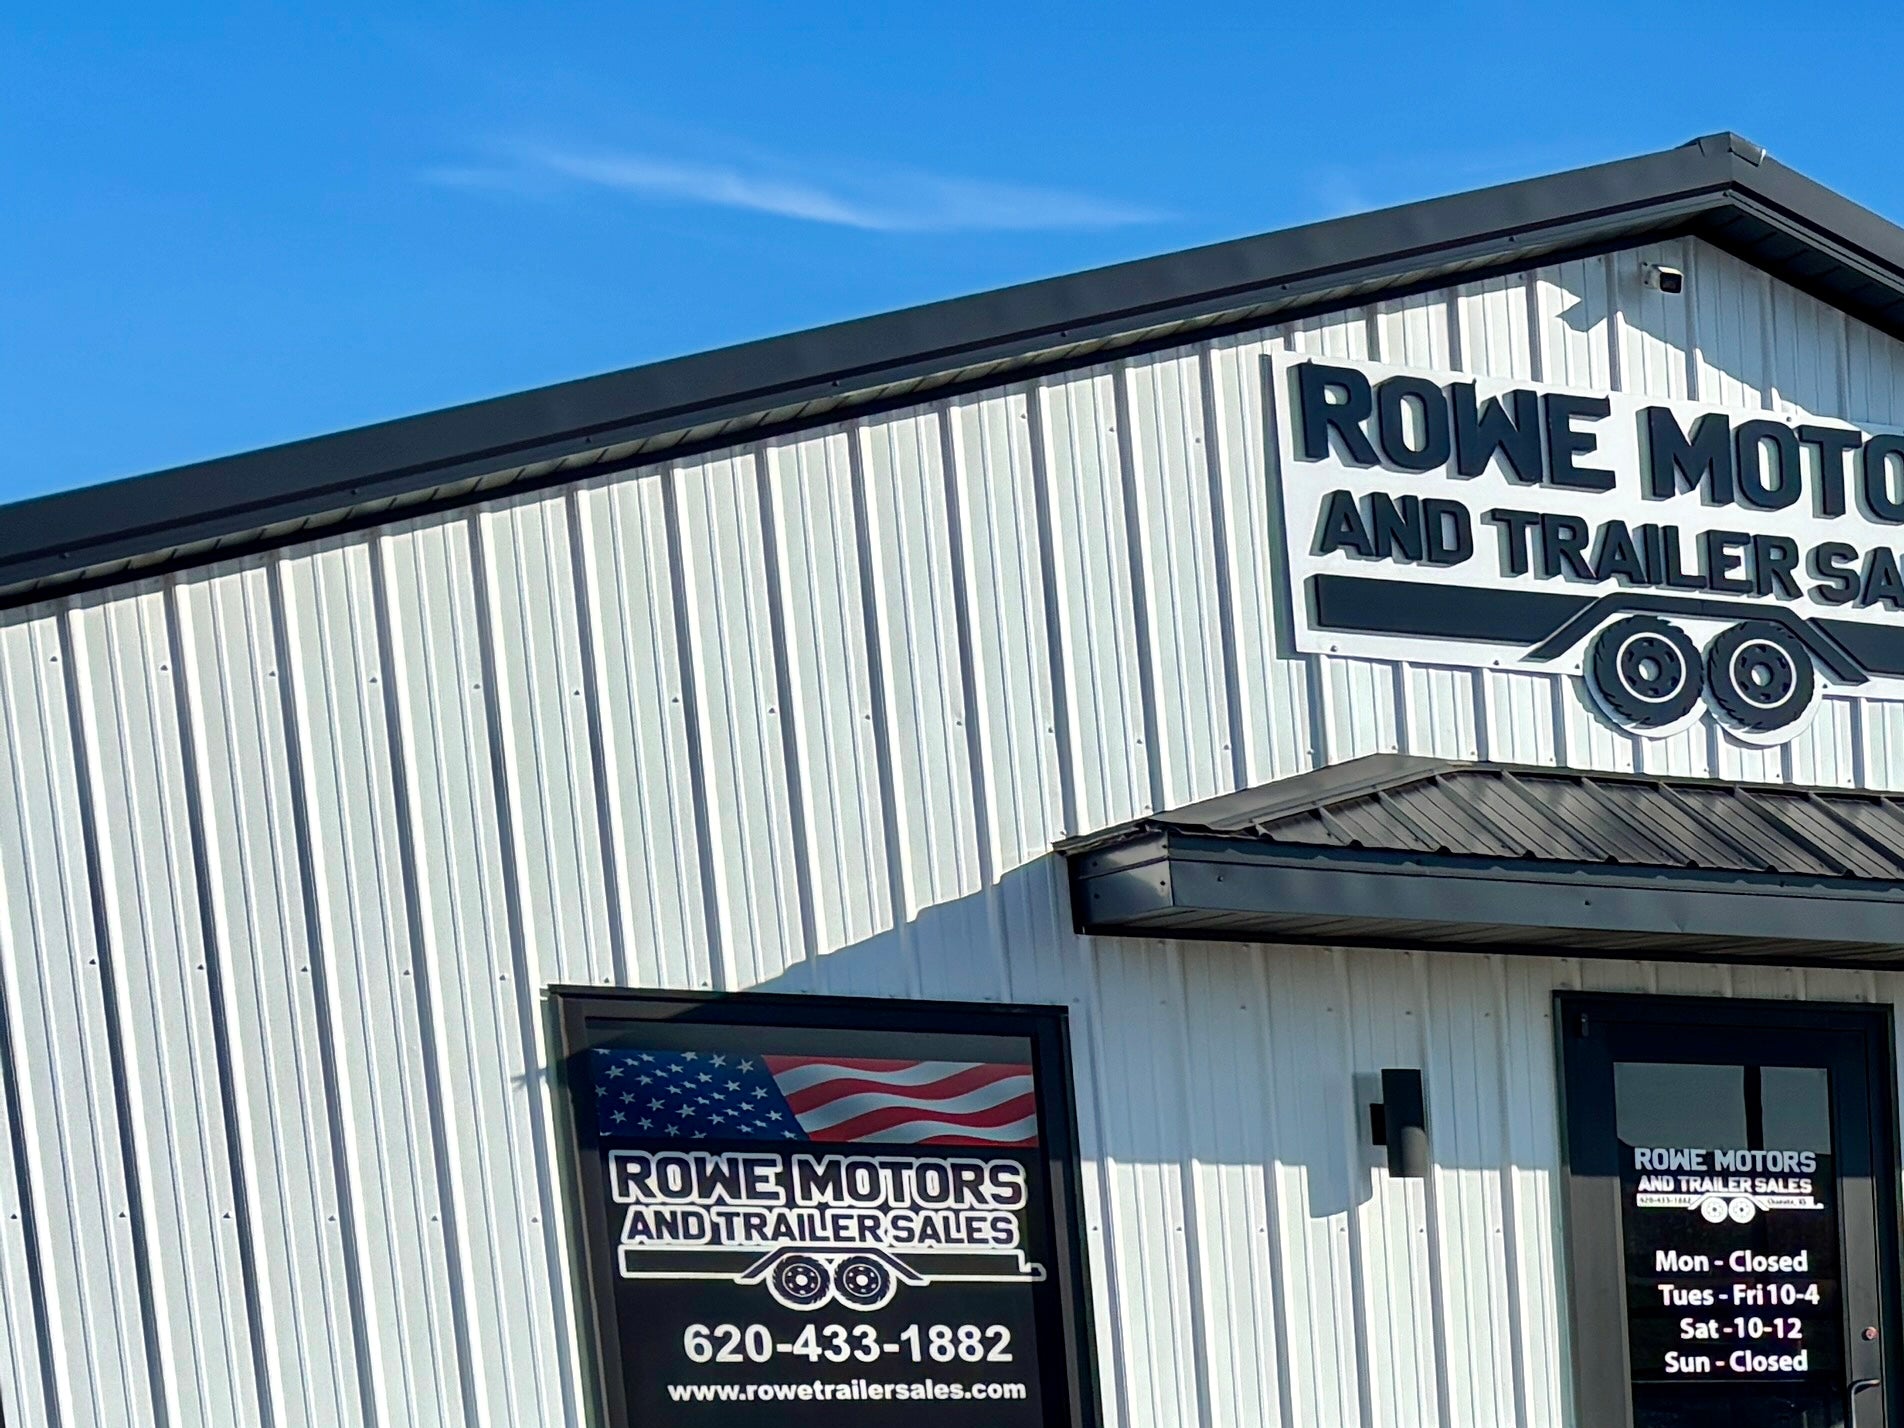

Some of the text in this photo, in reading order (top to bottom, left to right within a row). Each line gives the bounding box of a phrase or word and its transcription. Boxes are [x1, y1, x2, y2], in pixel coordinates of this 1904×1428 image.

[1288, 360, 1616, 491] ROWE
[1311, 489, 1474, 567] AND
[1482, 506, 1801, 600] TRAILER
[1634, 1148, 1817, 1173] ROWE MOTORS
[611, 1152, 1027, 1210] ROWE MOTORS
[1638, 1175, 1812, 1194] AND TRAILER SALES
[622, 1206, 1020, 1248] AND TRAILER SALES
[1655, 1251, 1707, 1273] Mon
[1729, 1250, 1809, 1273] Closed
[1658, 1284, 1714, 1307] Tues
[1733, 1284, 1763, 1306] Fri
[1766, 1284, 1820, 1306] 10-4
[1680, 1318, 1719, 1340] Sat
[684, 1323, 1014, 1364] 620-433-1882
[1665, 1352, 1711, 1374] Sun
[1730, 1350, 1809, 1373] Closed
[667, 1380, 1027, 1402] www.rowetrailersales.com
